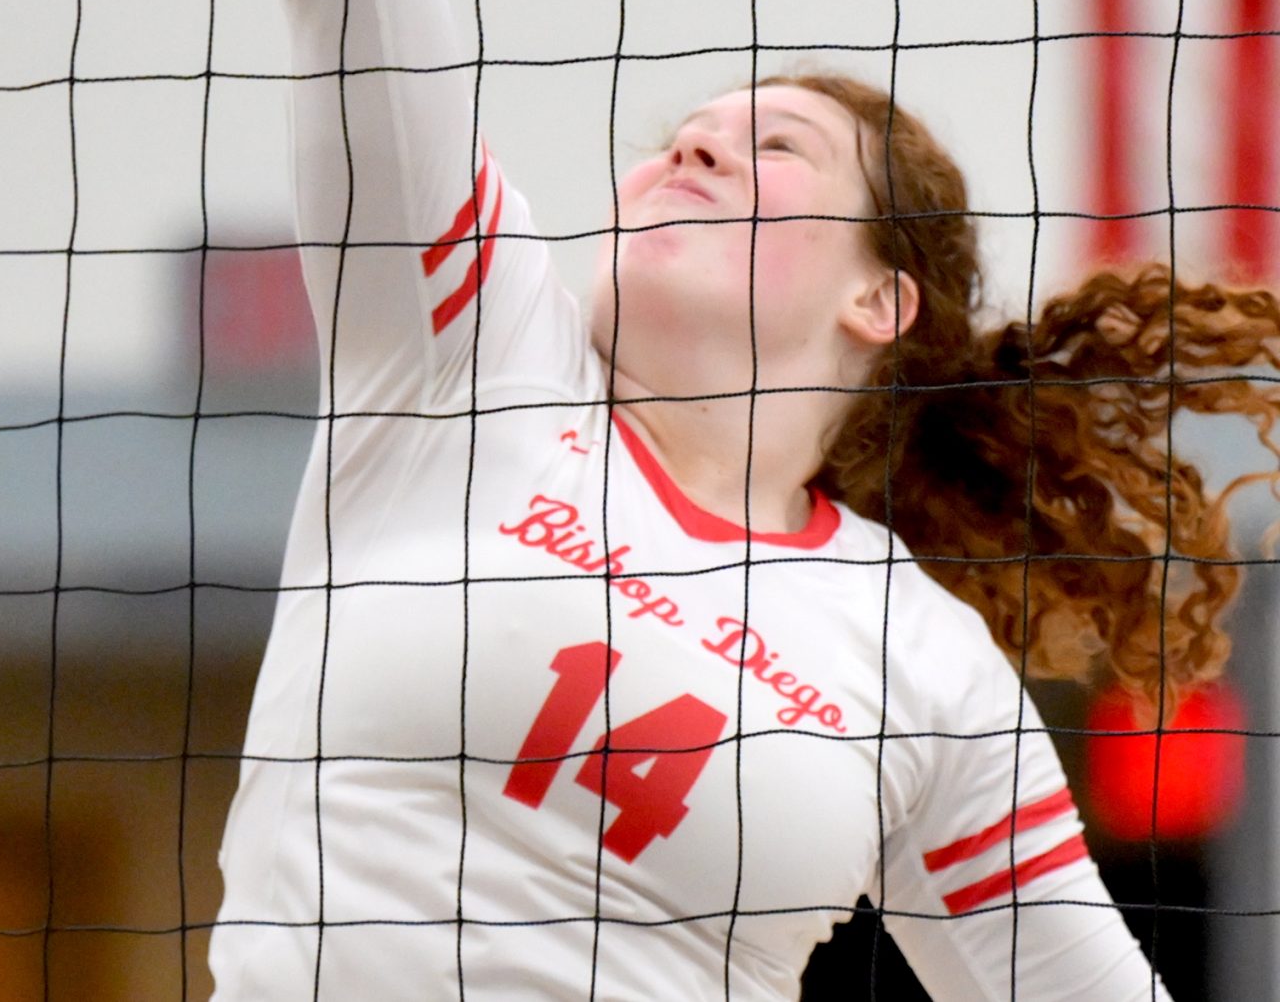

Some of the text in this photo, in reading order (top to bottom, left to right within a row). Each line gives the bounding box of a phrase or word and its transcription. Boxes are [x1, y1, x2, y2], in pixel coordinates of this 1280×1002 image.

[499, 494, 847, 734] Bishop Diego
[501, 641, 728, 865] 14
